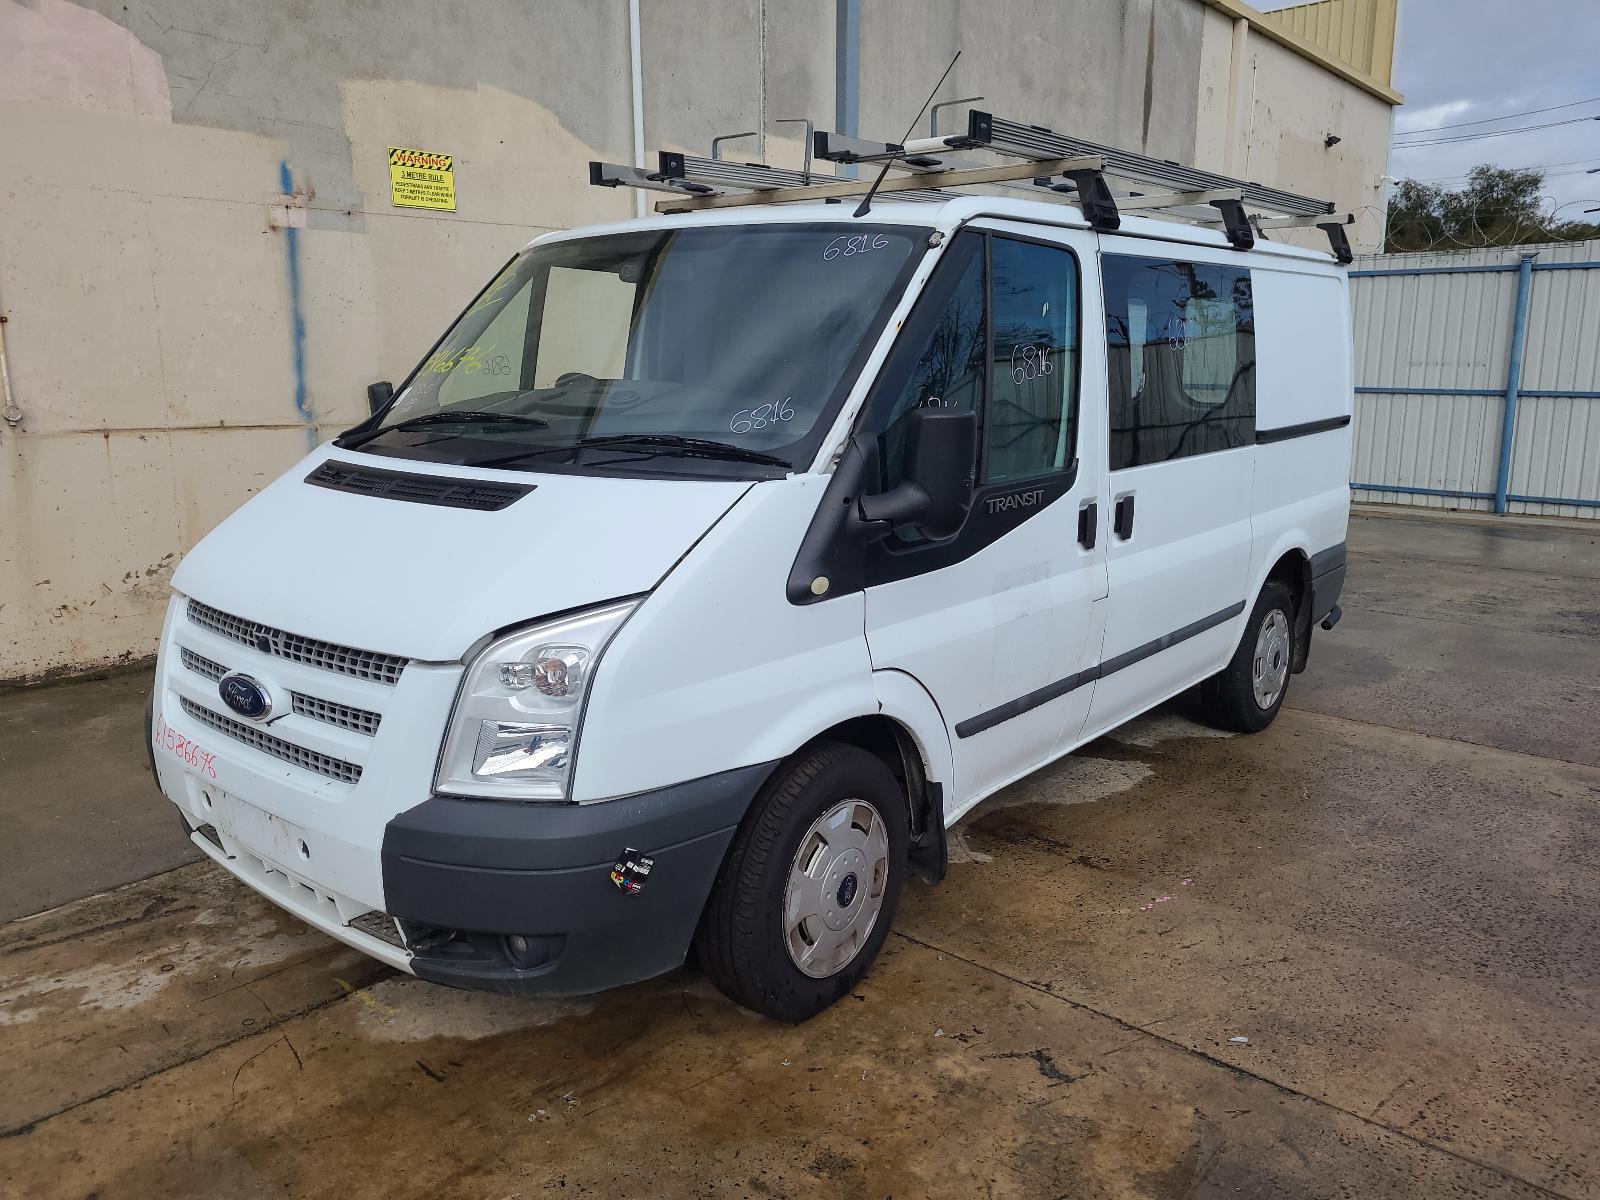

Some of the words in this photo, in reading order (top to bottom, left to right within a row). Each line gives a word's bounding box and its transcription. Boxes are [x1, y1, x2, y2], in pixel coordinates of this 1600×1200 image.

[396, 153, 447, 167] WARNING
[401, 170, 406, 178] 3
[407, 171, 427, 179] METRE
[428, 173, 444, 181] RULE
[823, 233, 889, 261] 6816
[1011, 344, 1053, 385] 6816
[730, 396, 795, 433] 6816
[986, 489, 1045, 514] TRANSIT
[225, 681, 252, 710] Ford
